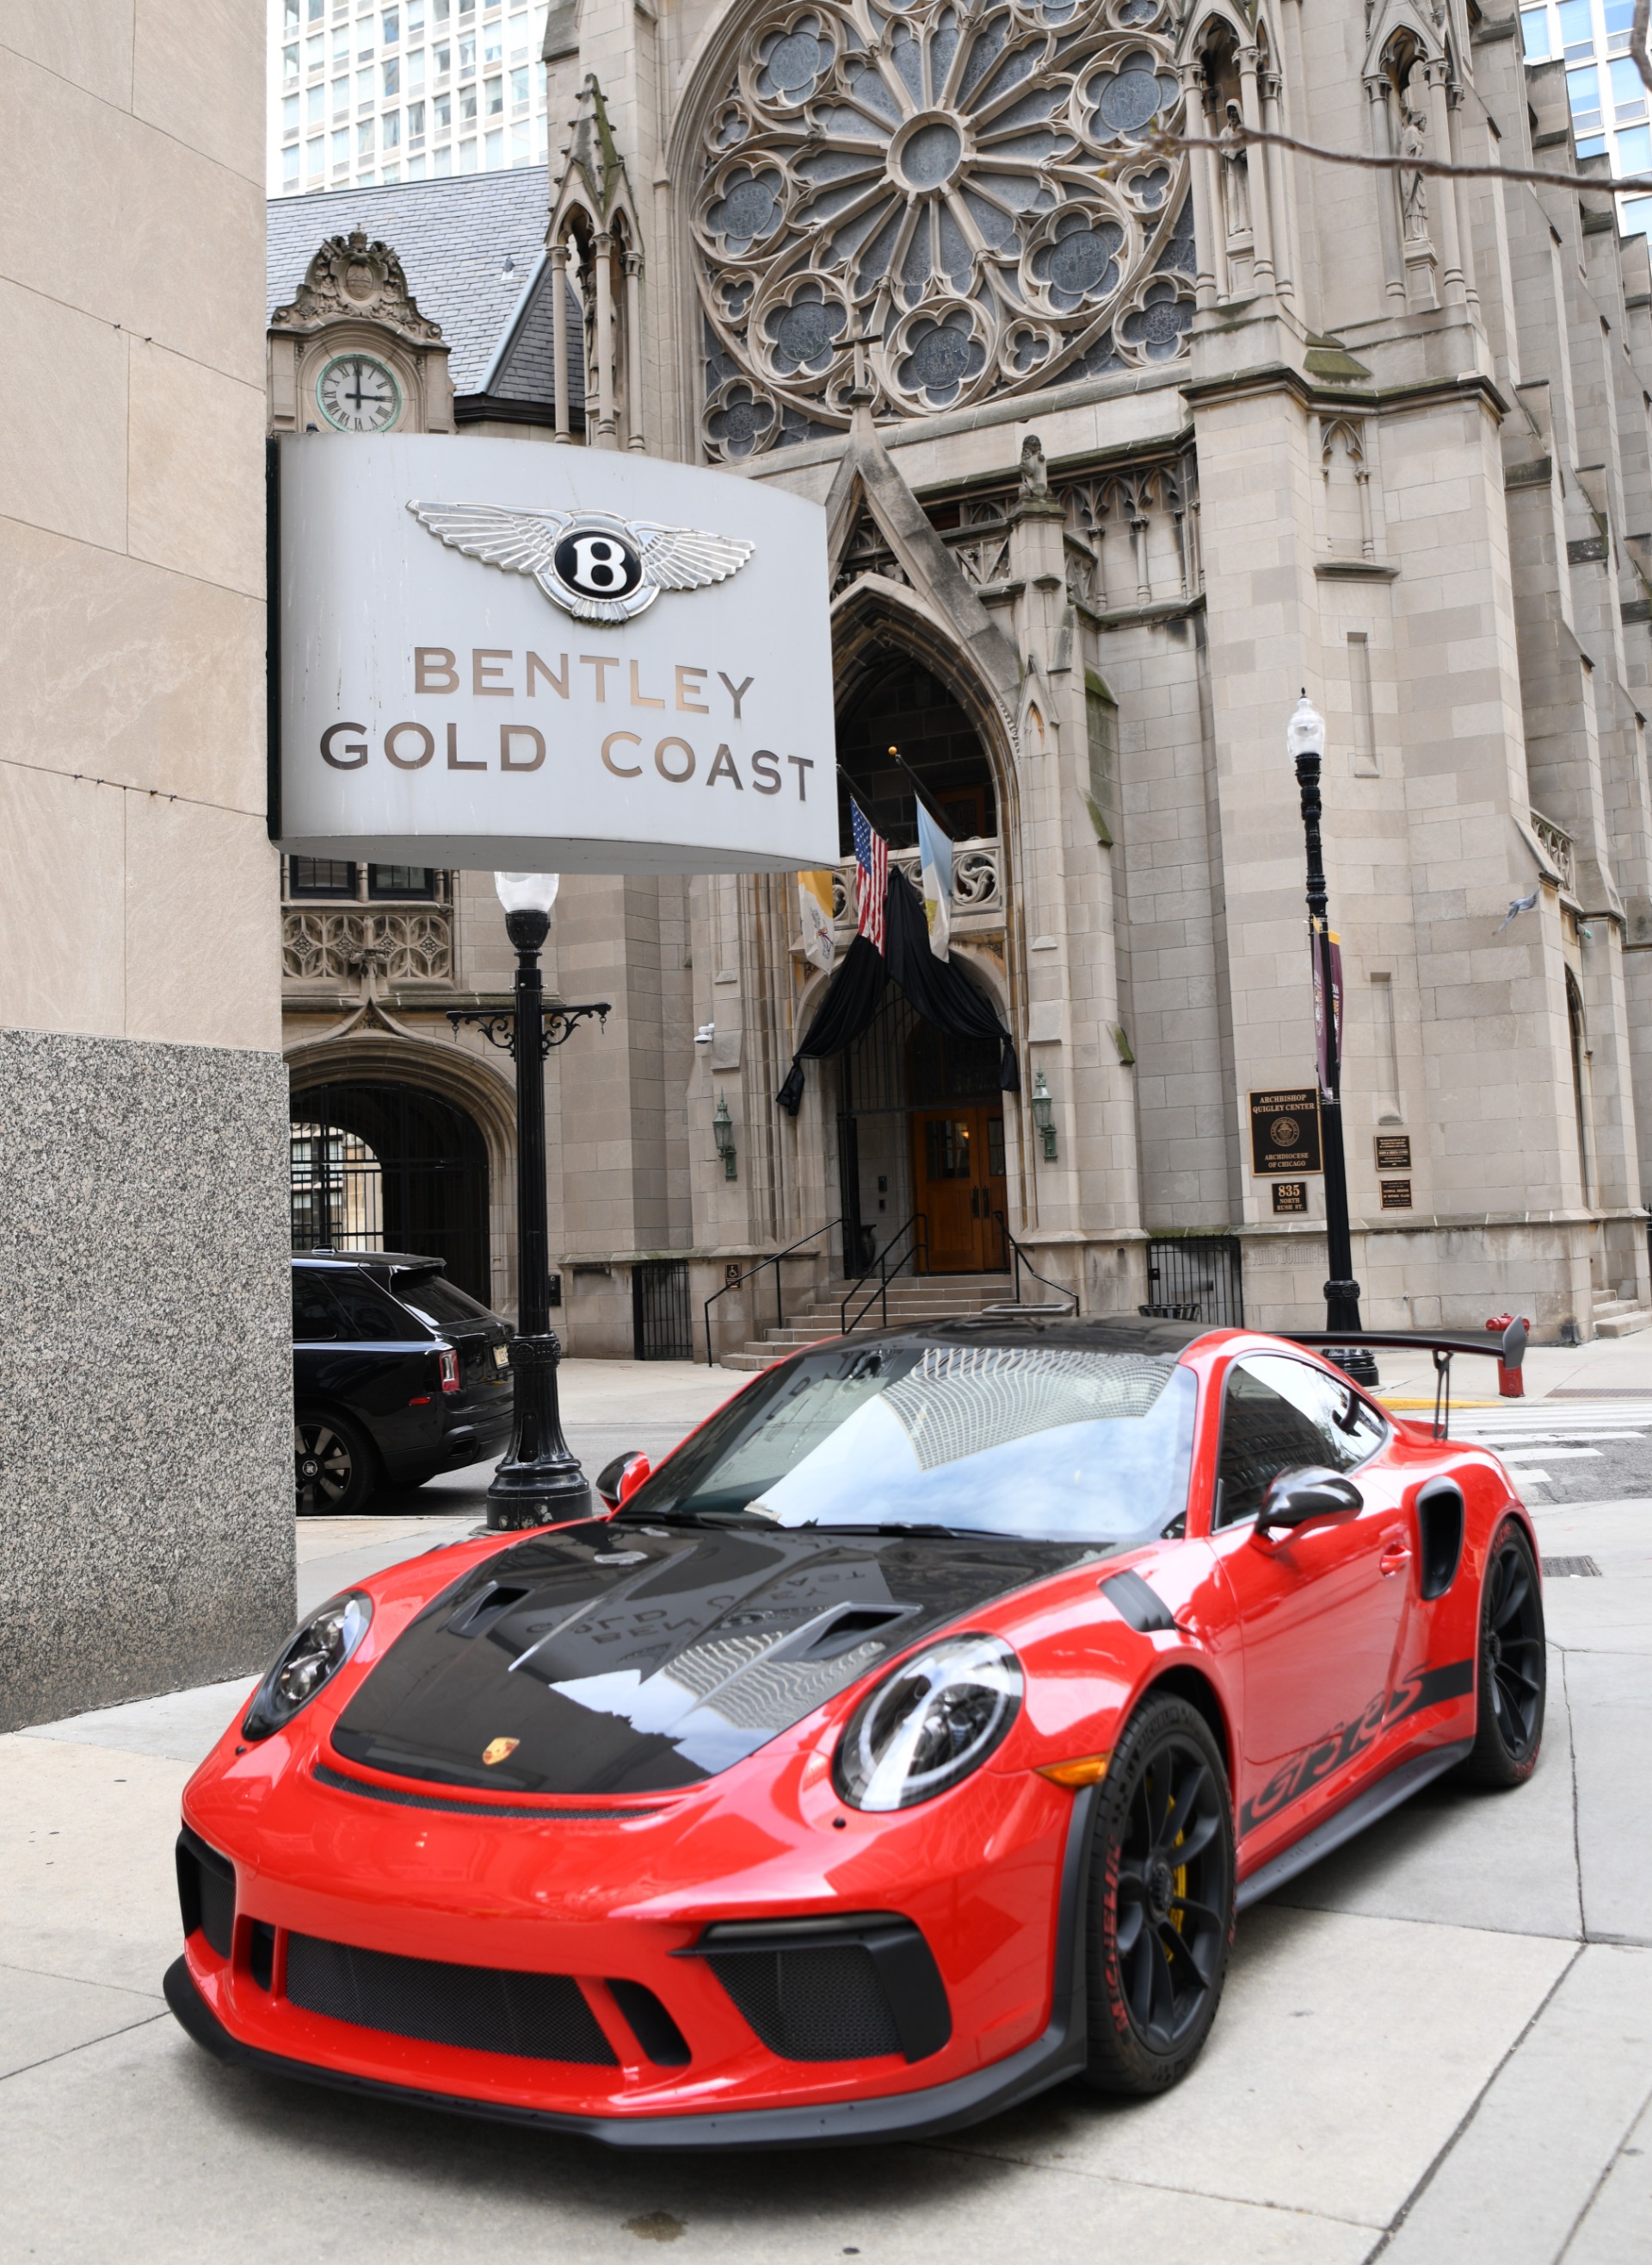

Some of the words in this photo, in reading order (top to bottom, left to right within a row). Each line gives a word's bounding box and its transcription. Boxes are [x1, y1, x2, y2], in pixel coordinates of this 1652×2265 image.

[337, 366, 350, 379] XI
[368, 368, 376, 380] I
[327, 378, 340, 386] X
[376, 380, 389, 389] II
[572, 536, 628, 594] B
[414, 646, 755, 719] BENTLEY
[319, 721, 546, 772] GOLD
[600, 730, 815, 802] COAST
[1260, 1094, 1306, 1103] ARCHBISHOP
[1253, 1105, 1285, 1114] QUIGLEY
[1279, 1184, 1300, 1197] 835
